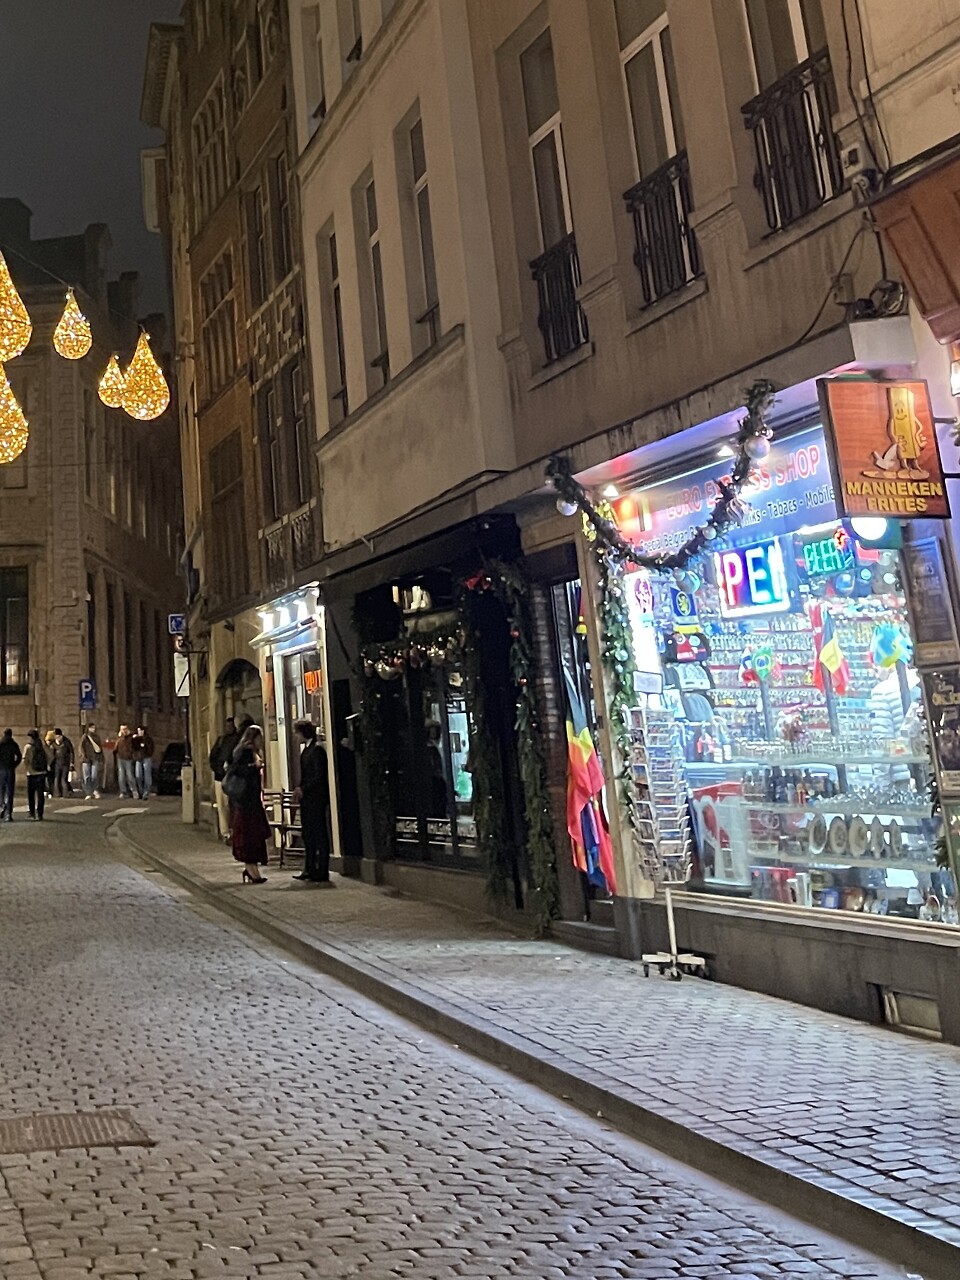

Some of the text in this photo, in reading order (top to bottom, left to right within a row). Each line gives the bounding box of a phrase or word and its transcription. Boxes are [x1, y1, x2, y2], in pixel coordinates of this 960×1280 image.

[775, 445, 820, 487] SHOP
[846, 481, 943, 496] MANNEKEN
[767, 499, 798, 519] Tabacs
[804, 484, 836, 509] Mobile
[867, 497, 928, 512] FRITES
[81, 682, 92, 698] P
